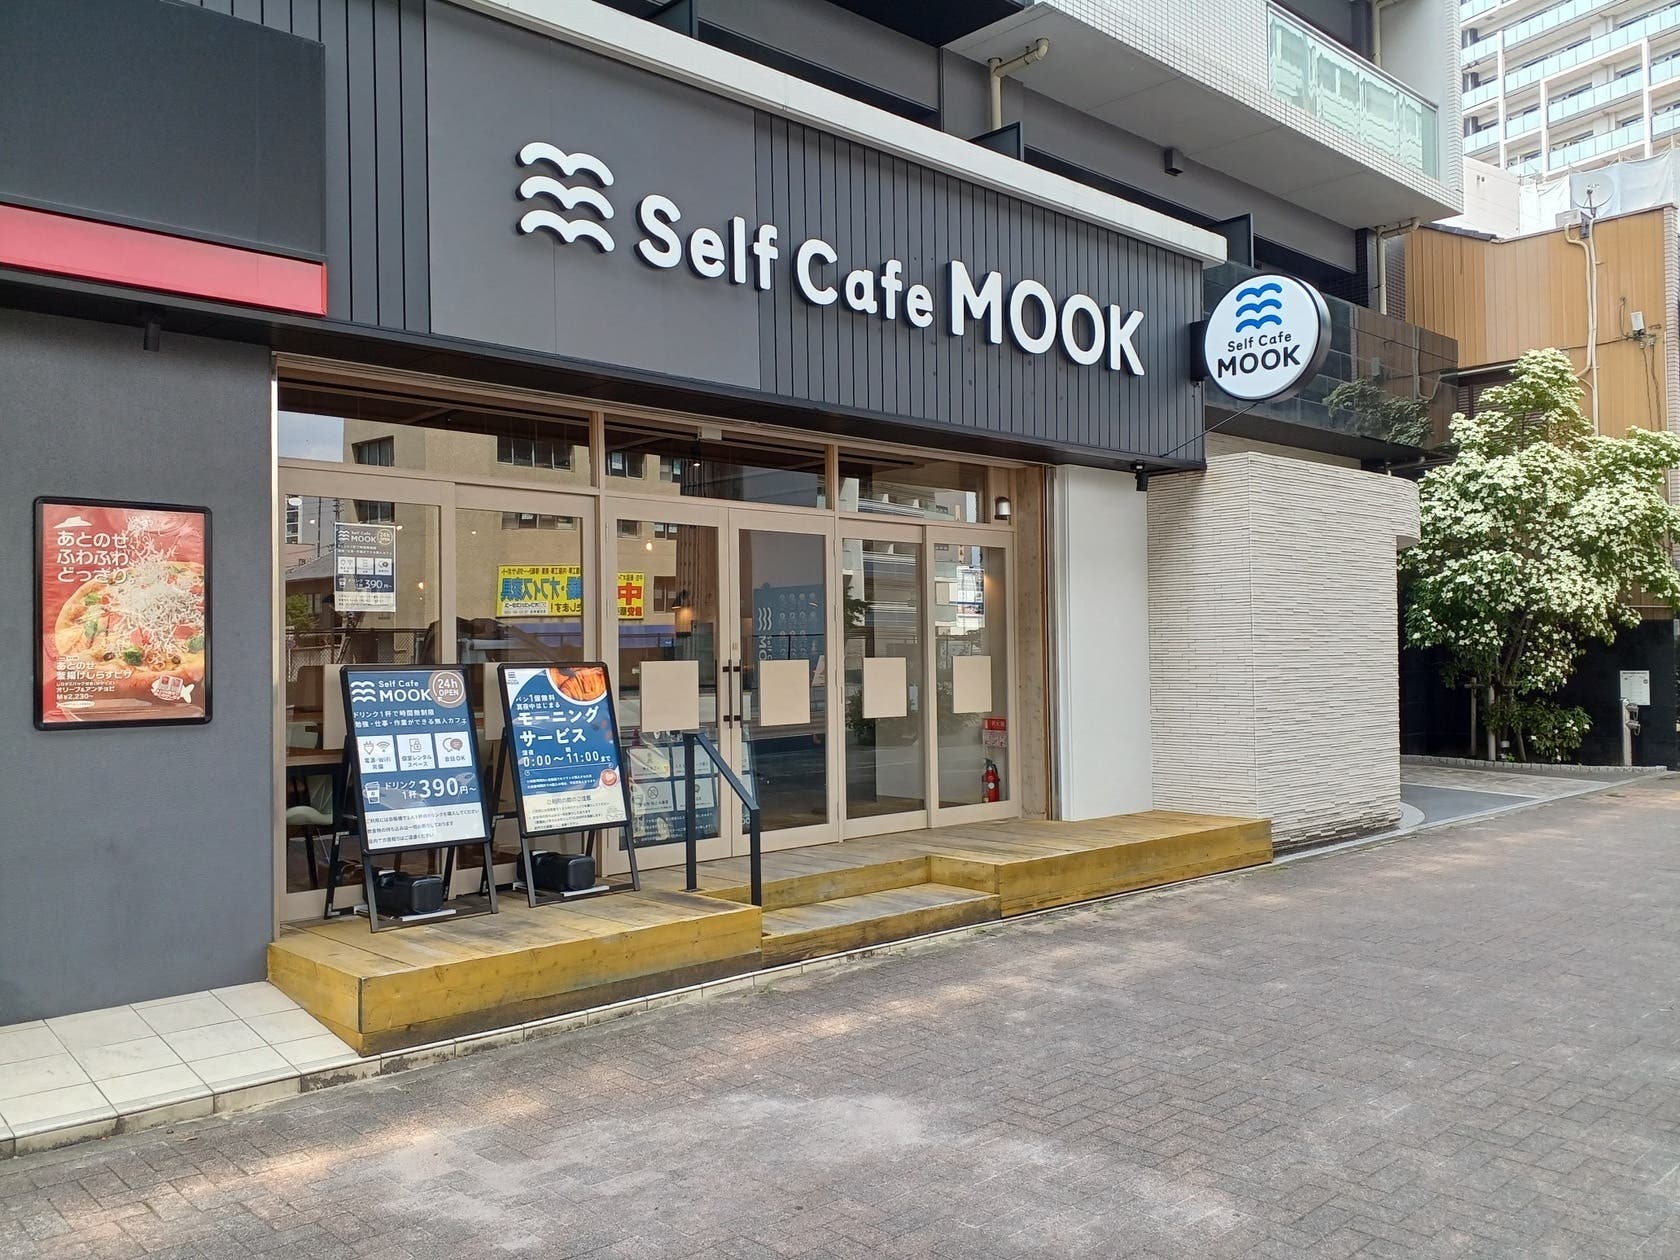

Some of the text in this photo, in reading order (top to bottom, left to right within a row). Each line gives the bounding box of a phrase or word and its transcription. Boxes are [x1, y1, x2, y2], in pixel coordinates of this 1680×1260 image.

[636, 194, 1145, 376] Self Cafe MOOK
[1227, 330, 1292, 352] Self Cafe
[1216, 344, 1301, 379] MOOK
[57, 530, 129, 549] あとのせ
[57, 549, 129, 566] ふわふわ
[378, 680, 419, 688] Self Cafe
[437, 679, 459, 690] 24h
[379, 688, 433, 703] MOOK
[439, 689, 460, 698] OPEN
[353, 709, 435, 718] ドリンク1杯で時間無制限
[517, 705, 599, 726] モーニング
[519, 727, 587, 747] サービス
[384, 780, 417, 791] ドリンク
[401, 790, 417, 801] 1杯
